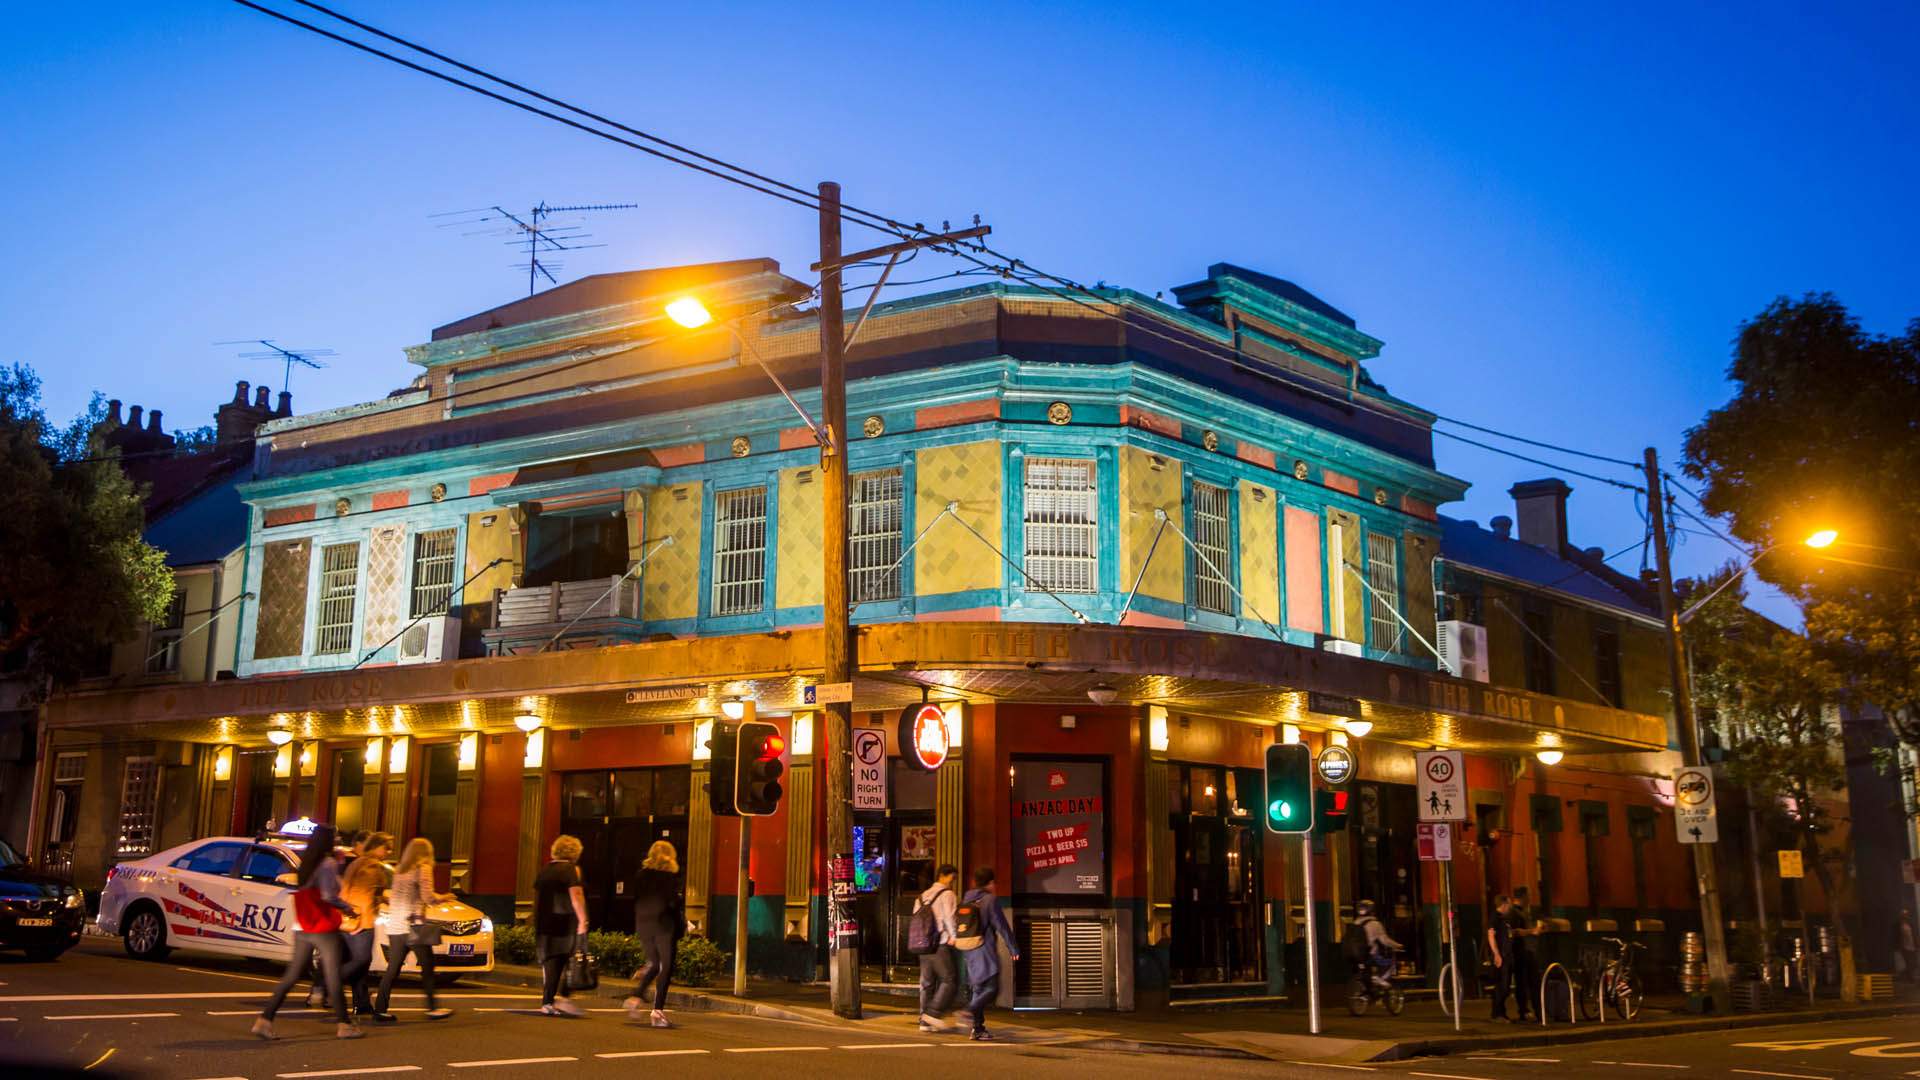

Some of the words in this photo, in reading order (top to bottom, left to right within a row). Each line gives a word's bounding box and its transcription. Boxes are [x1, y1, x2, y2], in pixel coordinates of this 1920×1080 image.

[970, 632, 1069, 657] THE
[1483, 691, 1533, 721] ROSE
[861, 769, 878, 781] NO
[1430, 763, 1449, 776] 40
[857, 784, 883, 793] RIGHT
[858, 796, 882, 805] TURN
[1021, 800, 1063, 816] ANZAC
[1068, 797, 1094, 815] DAY
[1046, 829, 1064, 840] TWO
[1064, 826, 1075, 837] UP
[1026, 845, 1047, 857] PIZZA
[1047, 844, 1054, 853] &
[1056, 841, 1075, 852] BEER
[1075, 838, 1089, 849] $15
[1033, 860, 1049, 869] MON
[1048, 858, 1057, 866] 25
[1058, 855, 1075, 864] APRIL
[199, 908, 237, 928] TAXI
[240, 903, 287, 933] RSL
